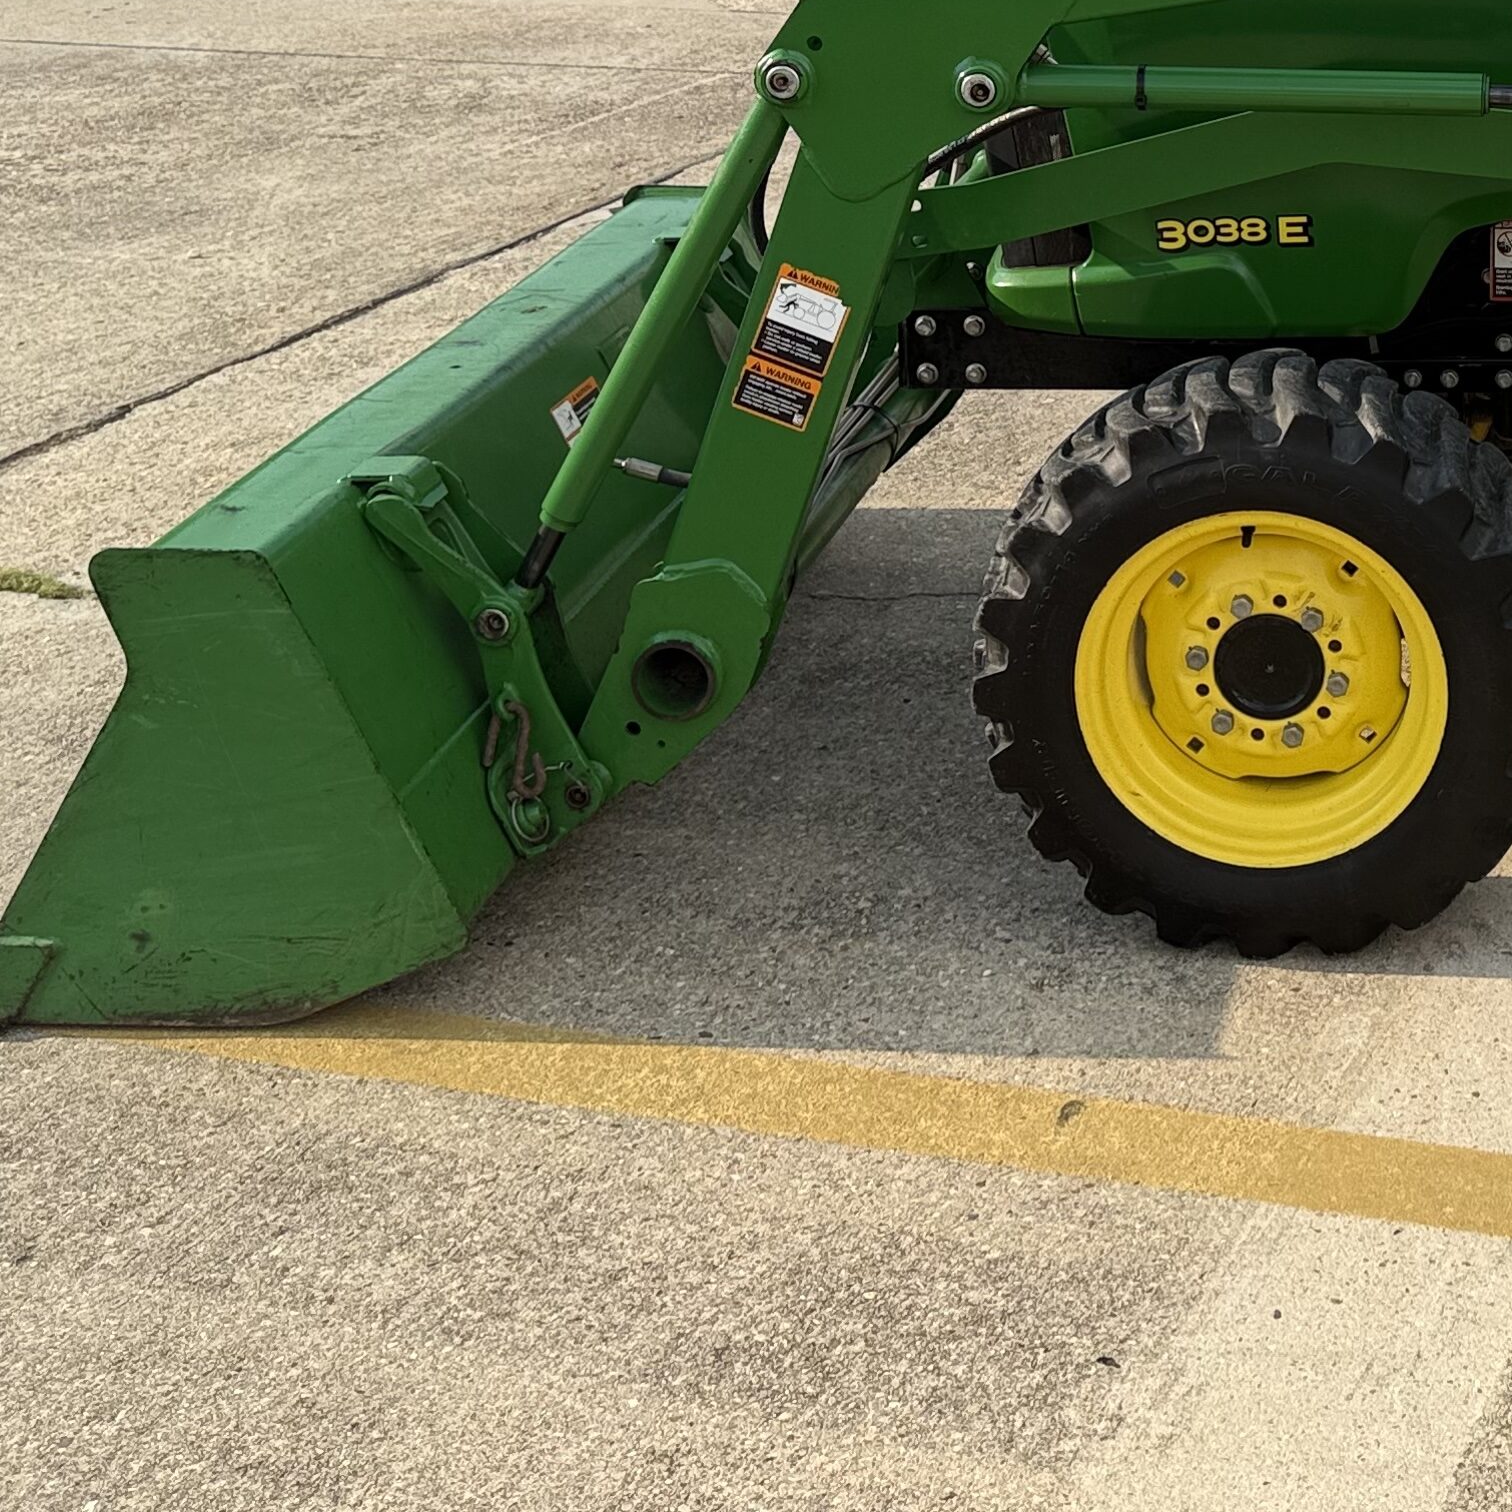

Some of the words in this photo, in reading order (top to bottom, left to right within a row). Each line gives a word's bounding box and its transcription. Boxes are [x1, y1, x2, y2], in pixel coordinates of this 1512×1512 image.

[1156, 217, 1268, 250] 3038
[1277, 215, 1309, 244] E
[799, 272, 840, 294] WARNIN
[765, 365, 813, 391] WARNING
